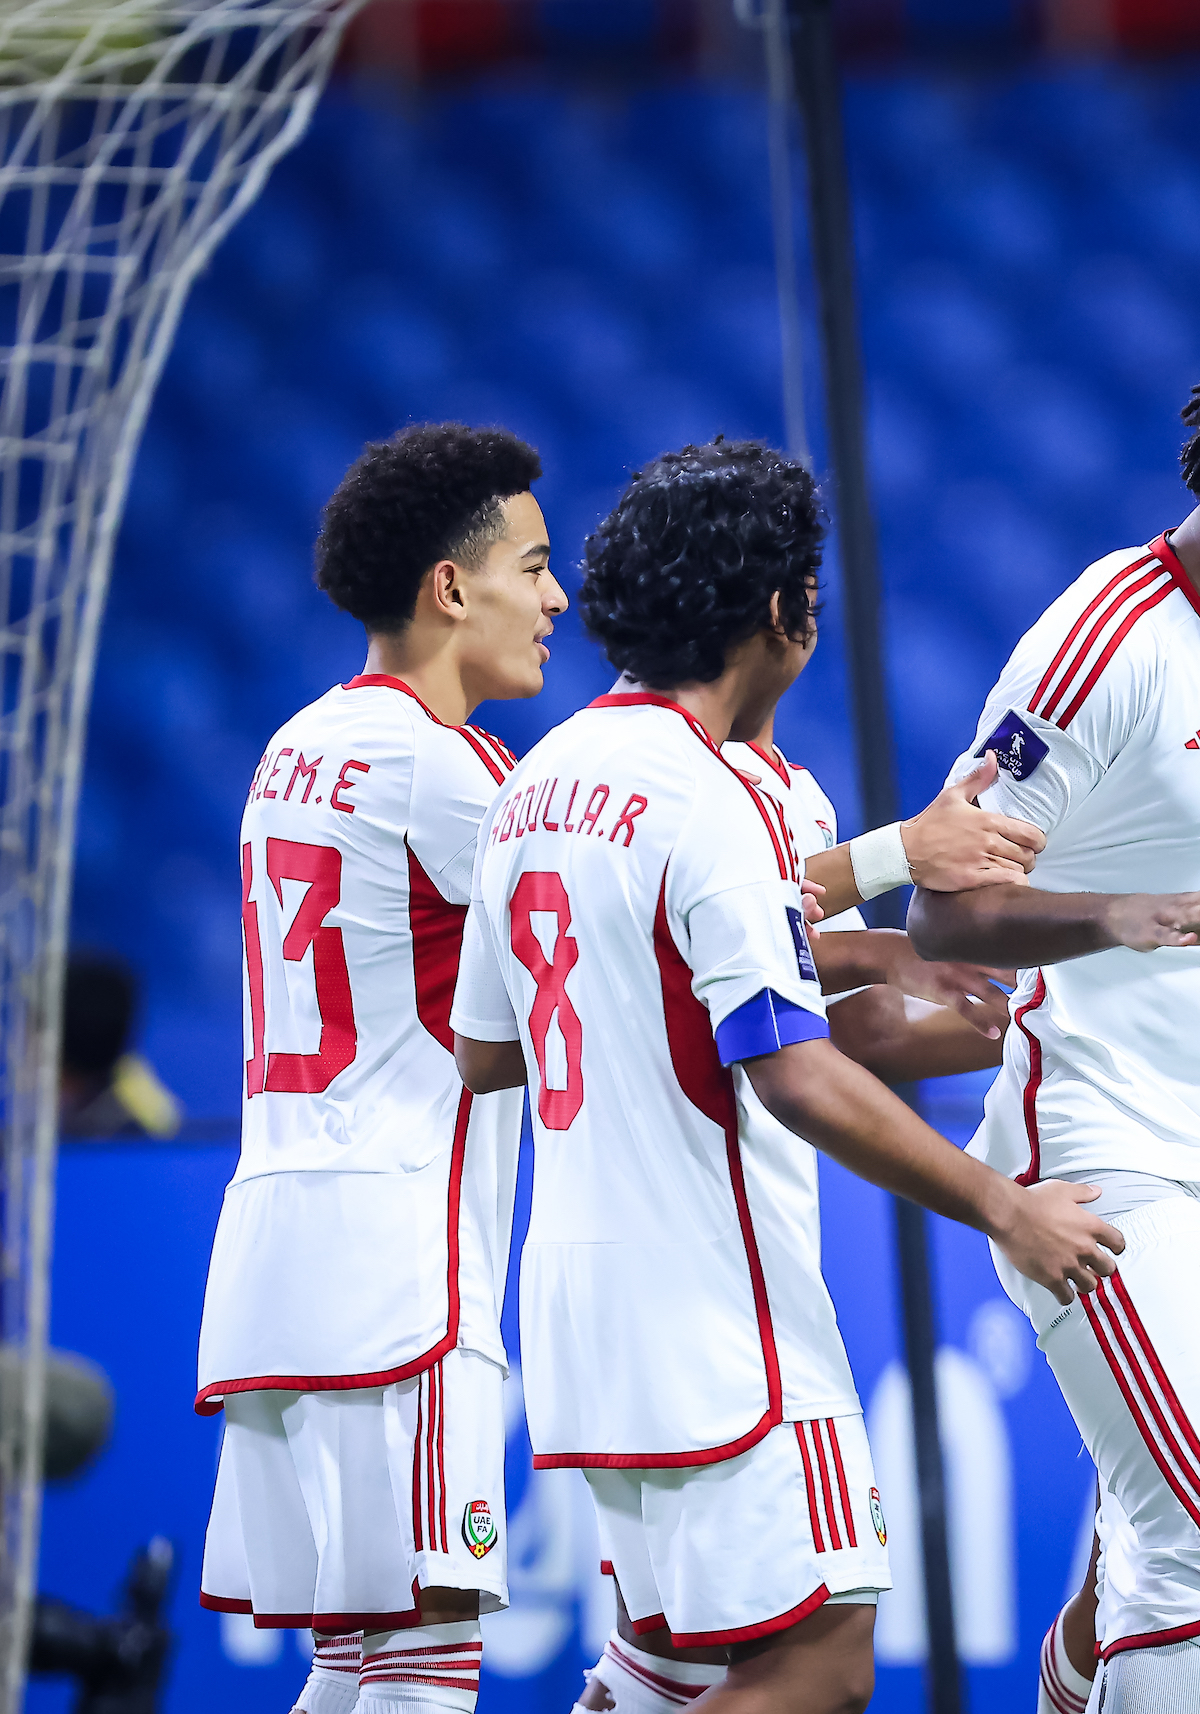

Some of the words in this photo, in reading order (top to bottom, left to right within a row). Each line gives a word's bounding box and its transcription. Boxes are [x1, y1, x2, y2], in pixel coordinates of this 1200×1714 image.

[241, 836, 358, 1099] 13
[509, 871, 584, 1131] 8
[473, 1516, 491, 1525] UAE
[477, 1525, 488, 1533] FA
